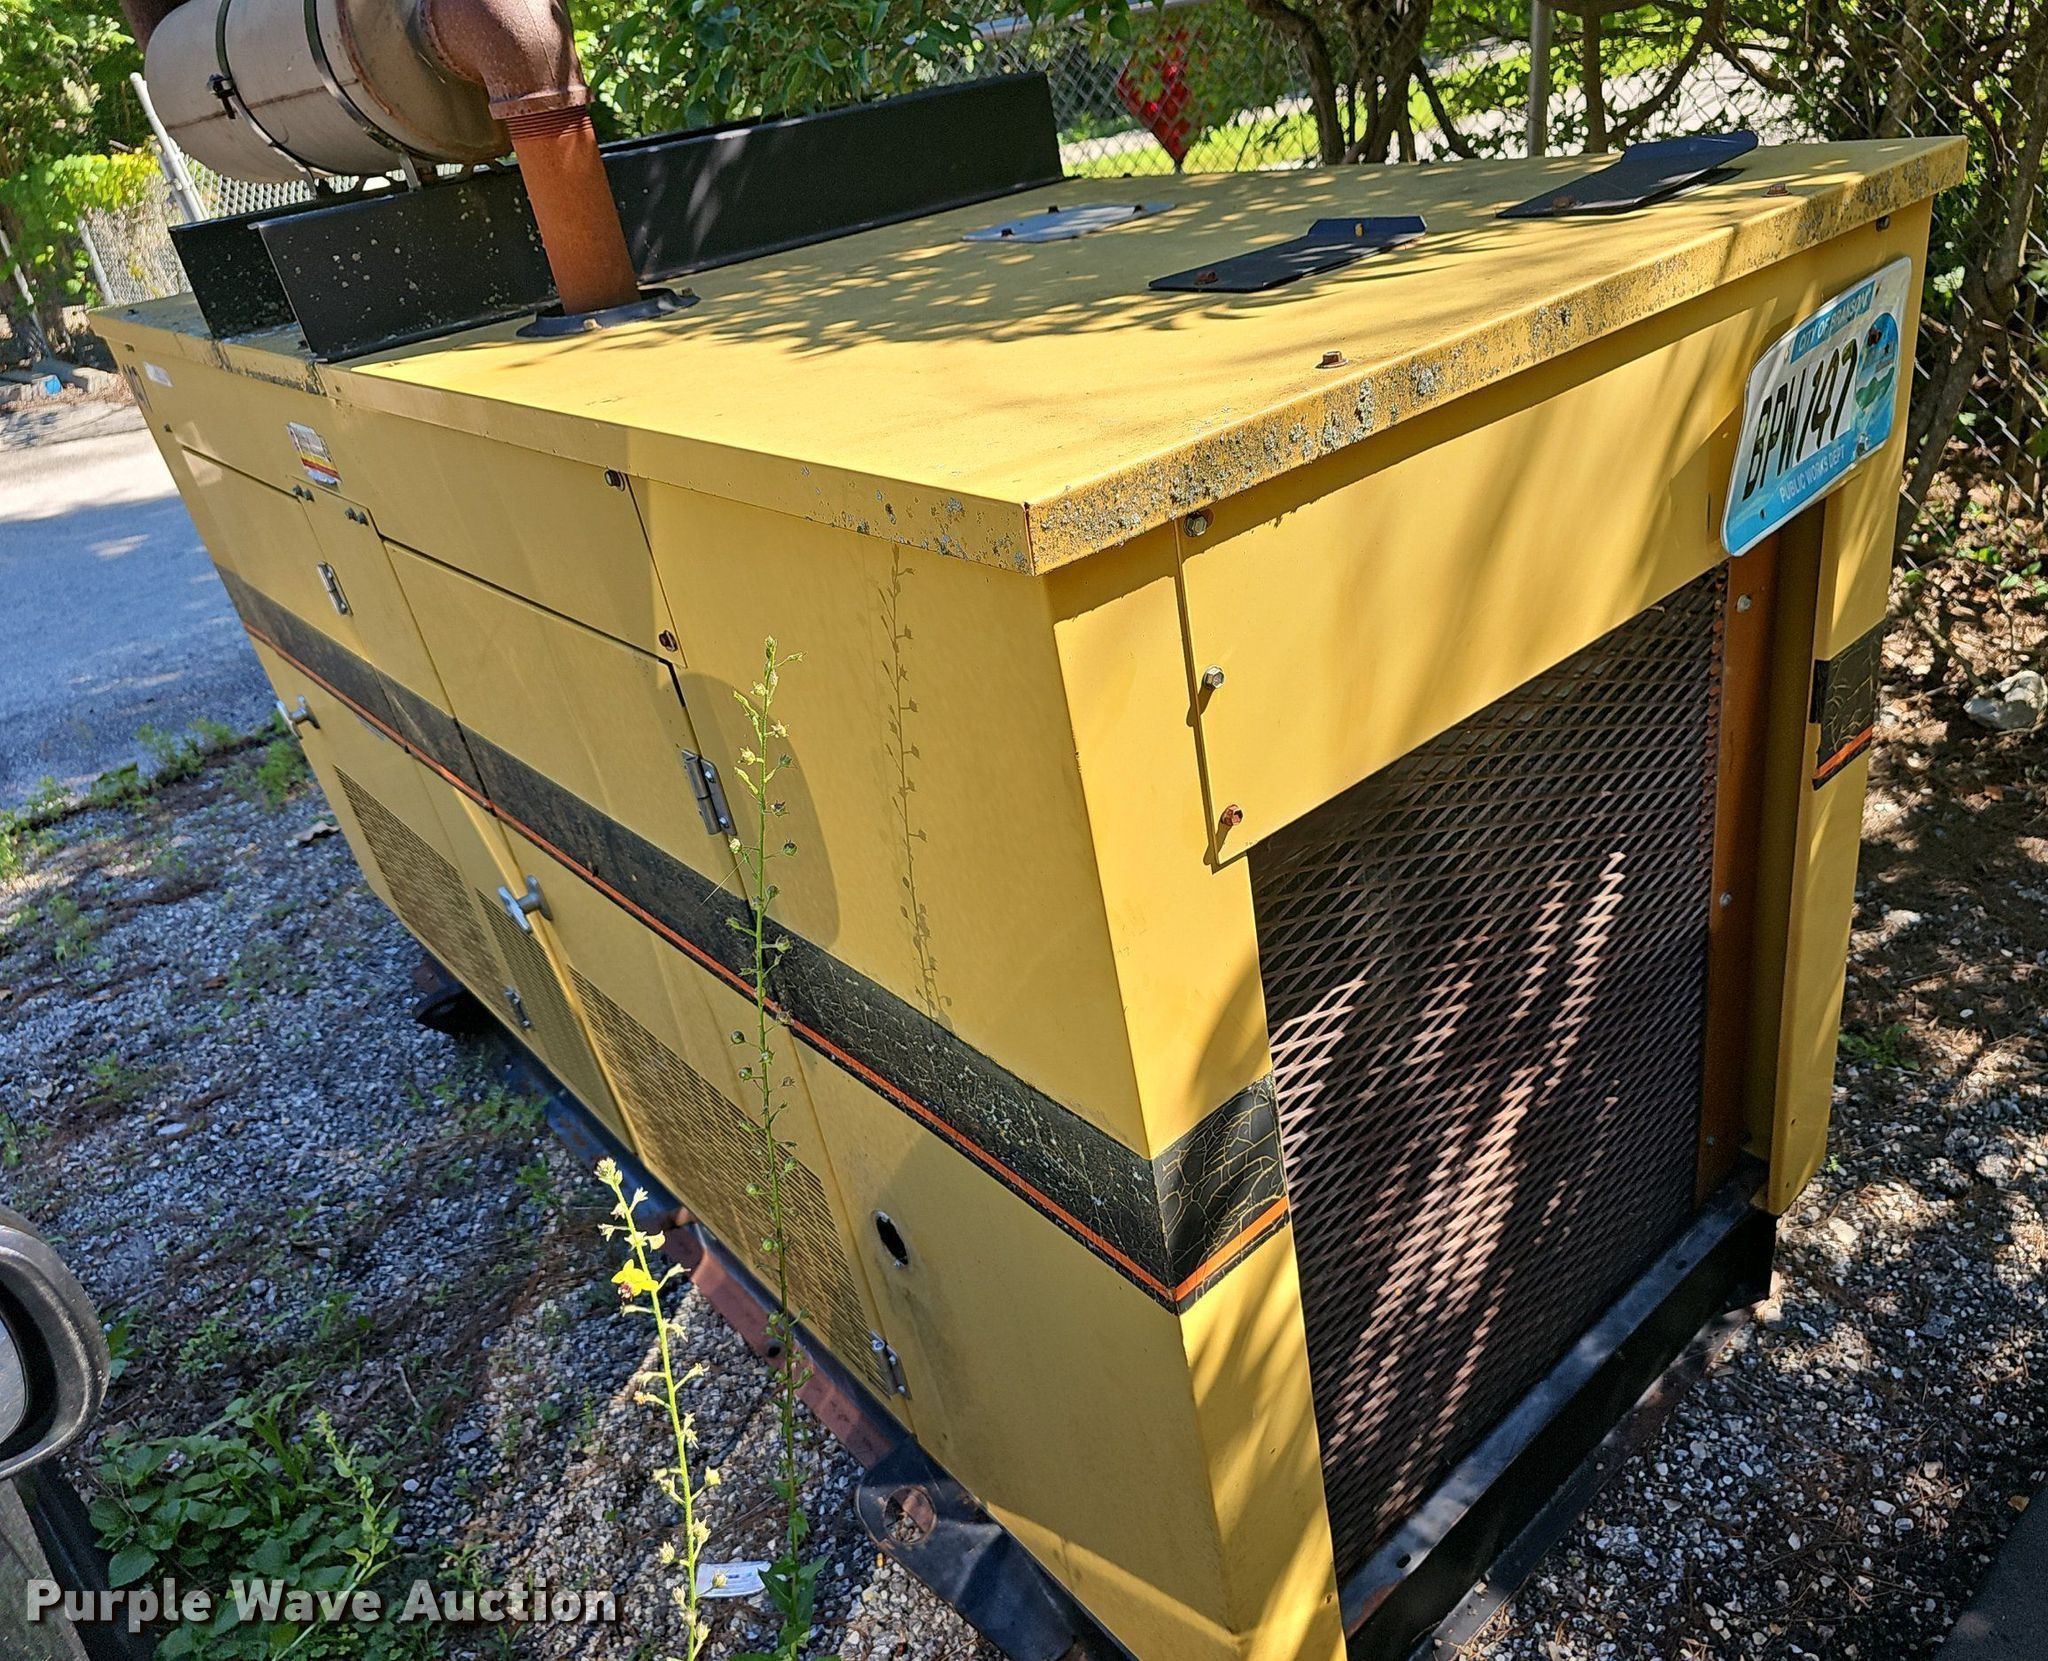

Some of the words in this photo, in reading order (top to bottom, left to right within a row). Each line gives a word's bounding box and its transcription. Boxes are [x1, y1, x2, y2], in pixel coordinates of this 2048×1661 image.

[1798, 325, 1818, 351] CITY
[1779, 473, 1806, 503] PUBLIC
[1805, 456, 1829, 486] WORKS
[1829, 444, 1846, 469] DEPT
